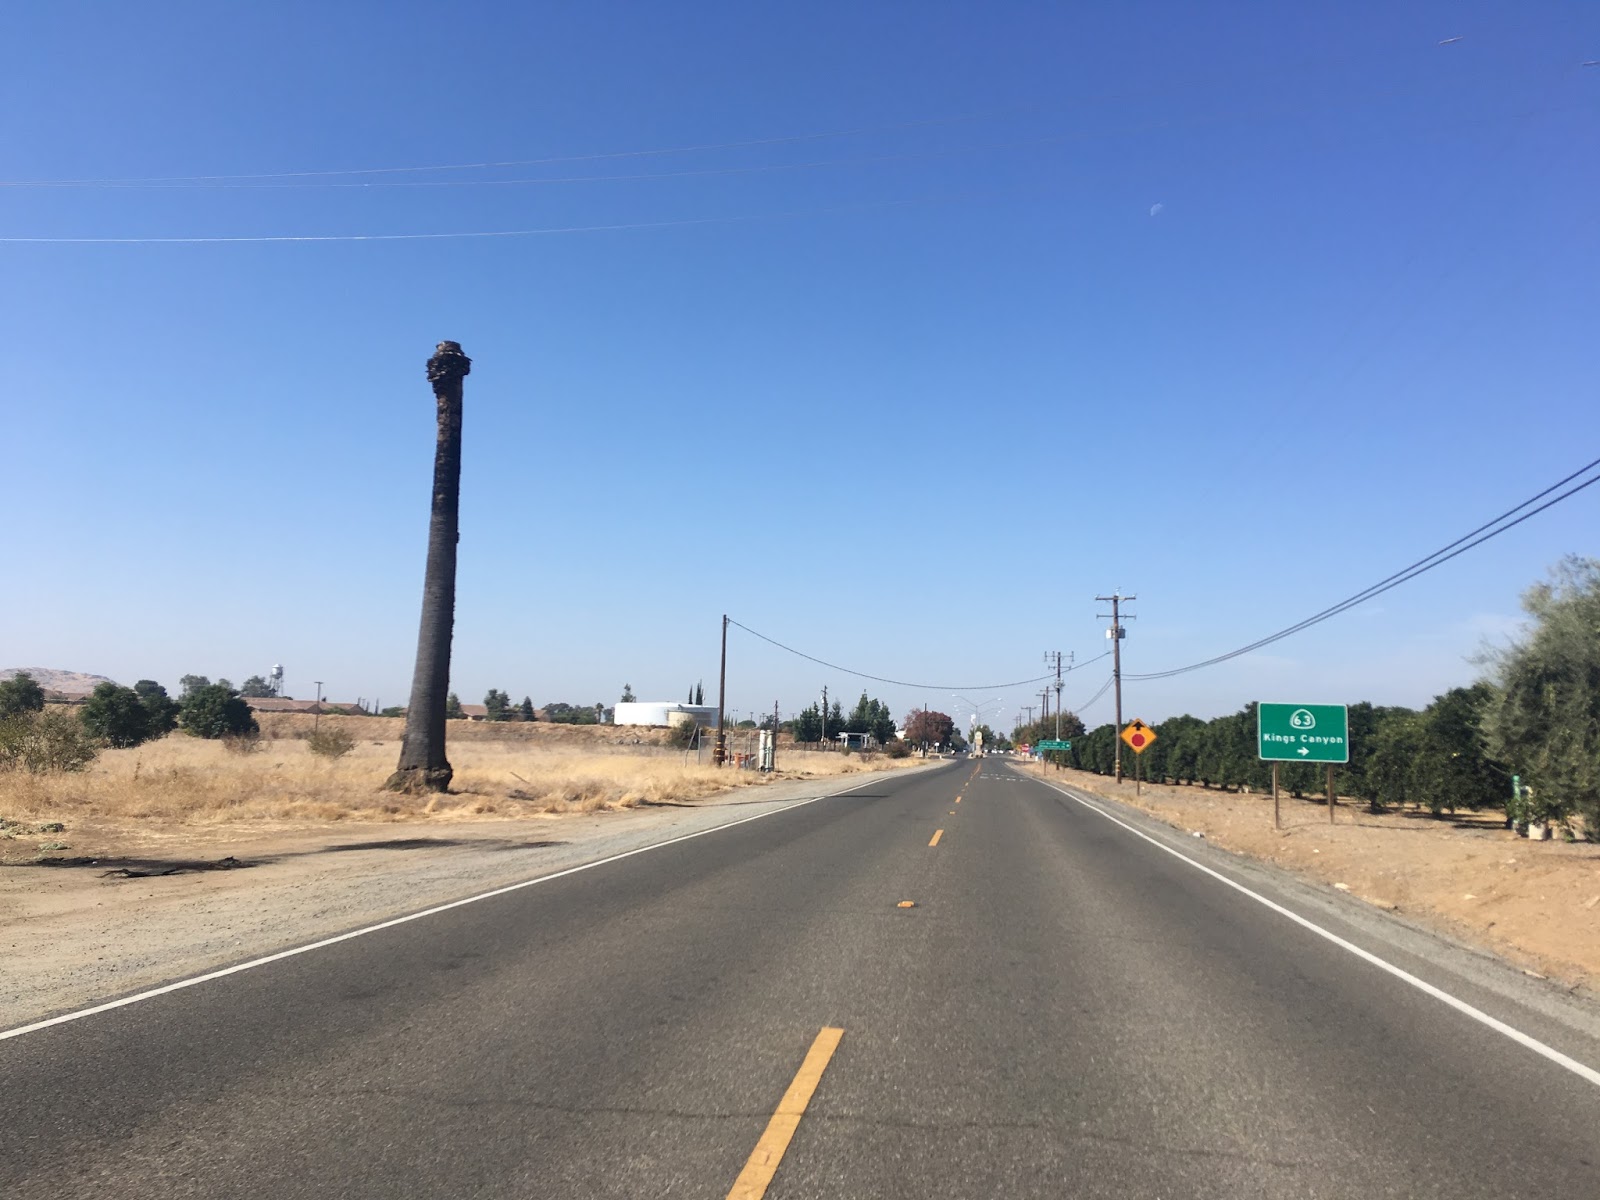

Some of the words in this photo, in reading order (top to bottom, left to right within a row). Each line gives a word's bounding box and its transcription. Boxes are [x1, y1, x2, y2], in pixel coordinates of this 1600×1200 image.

[1294, 716, 1311, 725] 63
[1263, 733, 1295, 744] Kings
[1300, 735, 1343, 744] Canyon
